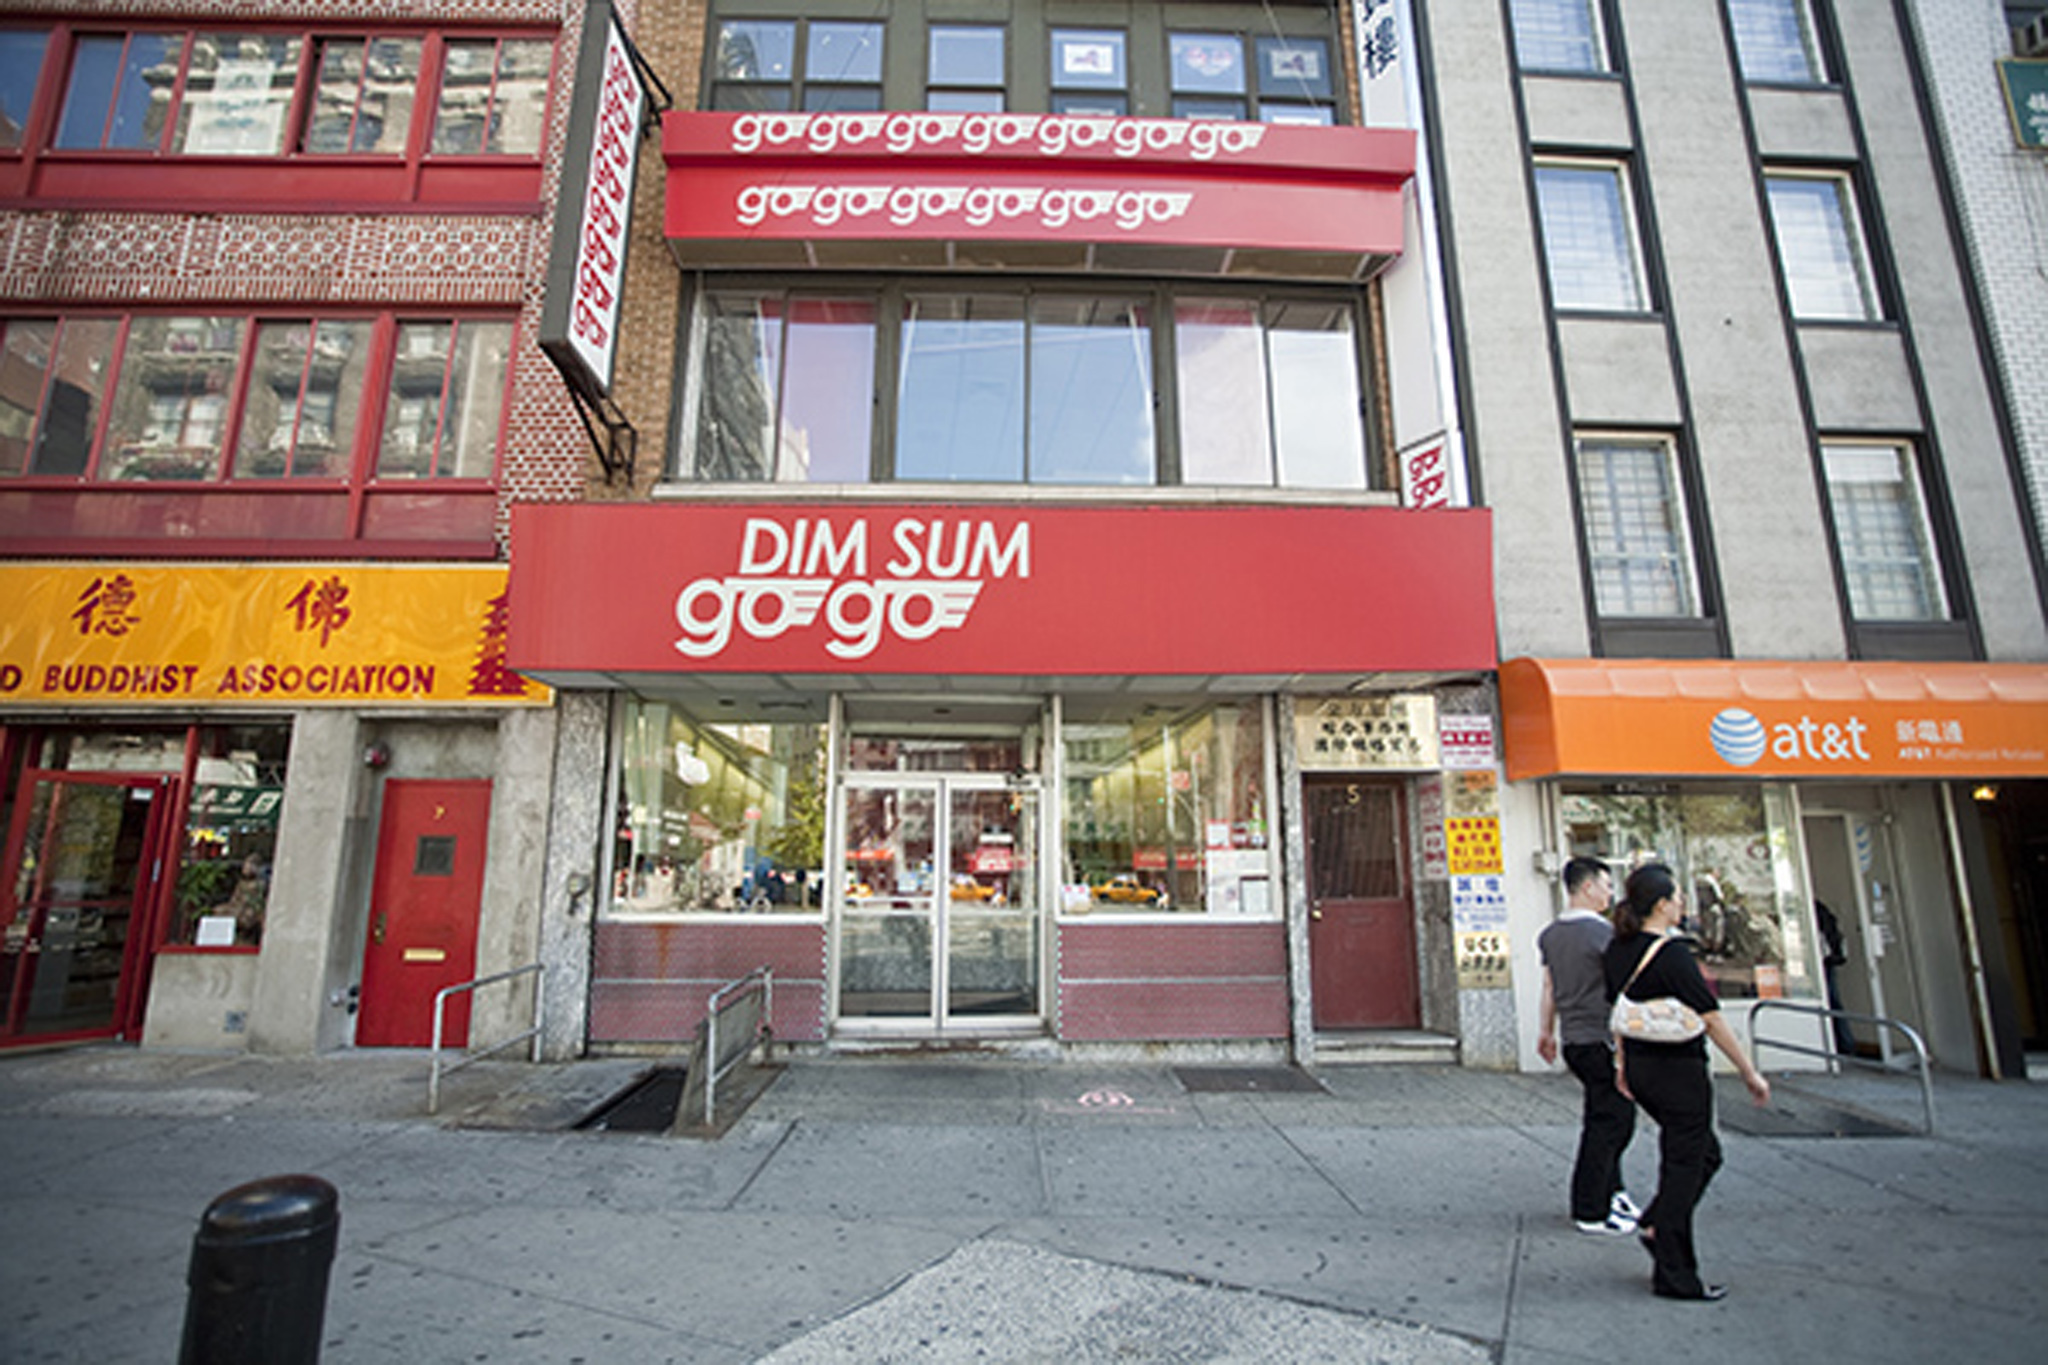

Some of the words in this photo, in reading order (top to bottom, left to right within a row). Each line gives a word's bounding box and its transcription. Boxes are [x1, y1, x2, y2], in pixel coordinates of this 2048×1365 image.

[739, 518, 867, 576] DIM
[886, 518, 1030, 578] SUM
[71, 574, 140, 637] 德
[286, 576, 351, 648] 佛
[43, 664, 198, 693] BUDDHIST
[217, 664, 435, 694] ASSOCIATION
[1772, 716, 1870, 760] at&t
